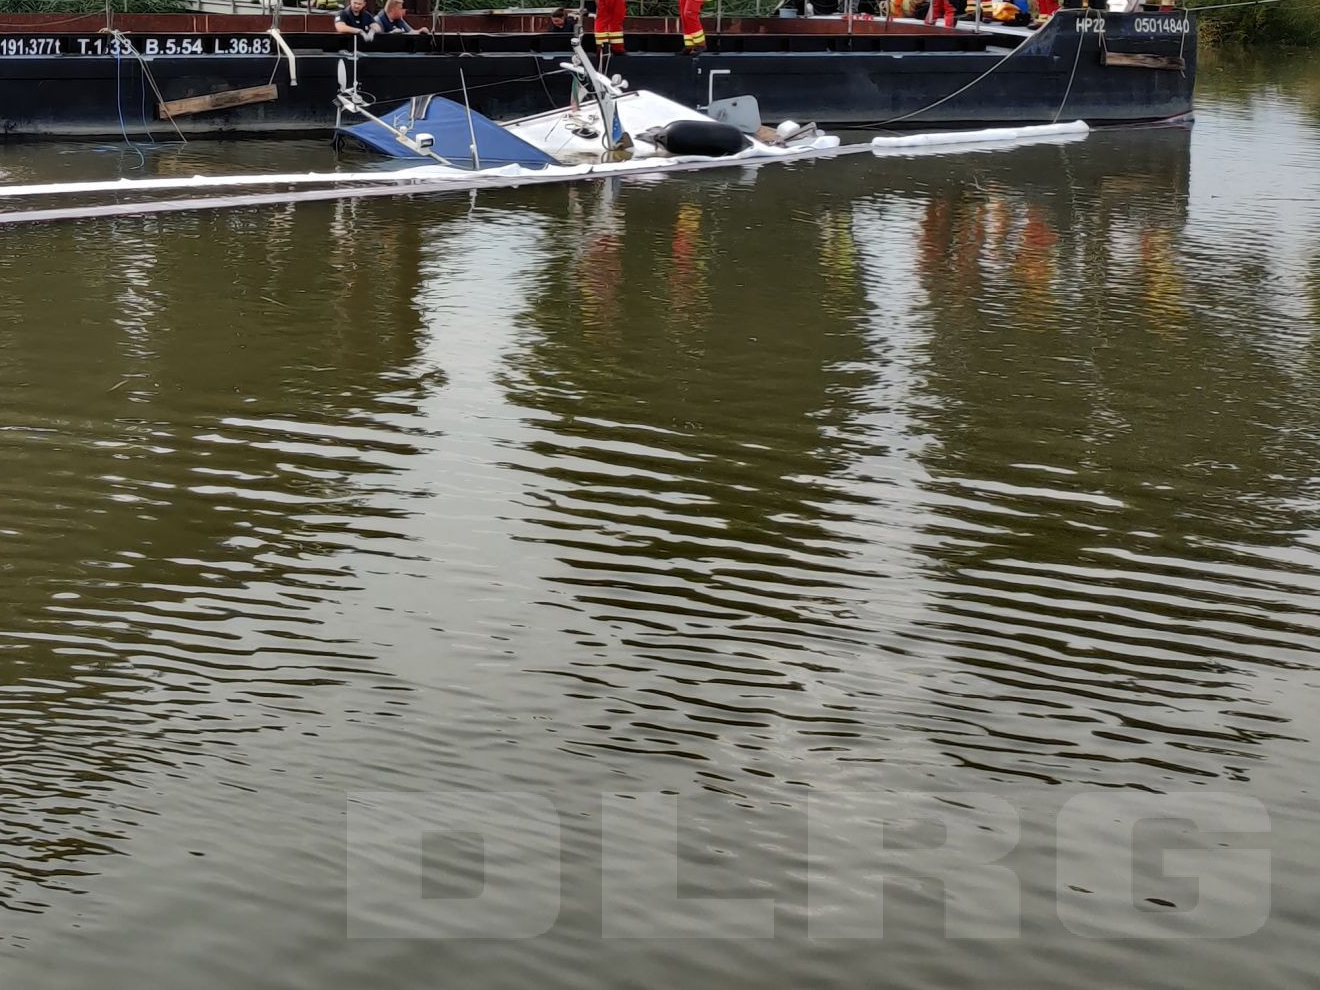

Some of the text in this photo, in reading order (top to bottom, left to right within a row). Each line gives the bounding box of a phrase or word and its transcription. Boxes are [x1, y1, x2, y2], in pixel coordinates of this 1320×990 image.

[1076, 17, 1190, 33] HP22 05014840
[0, 38, 61, 56] 191,377t
[145, 38, 203, 55] B.5,54
[214, 38, 271, 55] L.36,83
